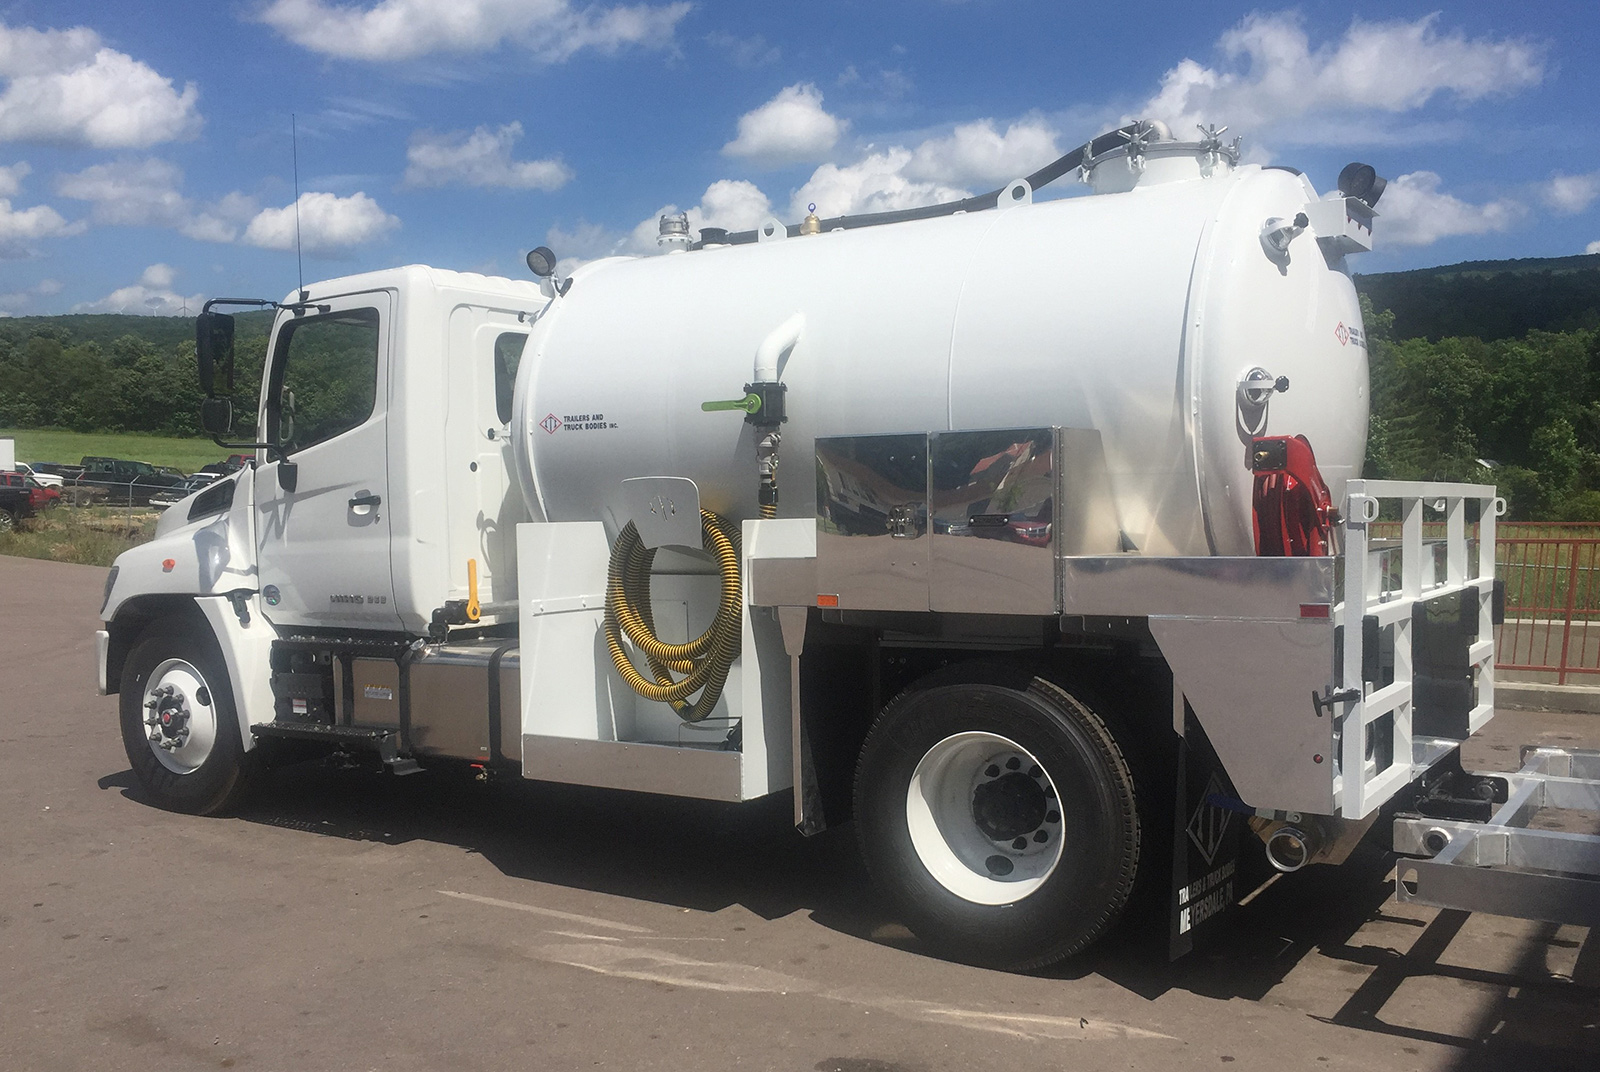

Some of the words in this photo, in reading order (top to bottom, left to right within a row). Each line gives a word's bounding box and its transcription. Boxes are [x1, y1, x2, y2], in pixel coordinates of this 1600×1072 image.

[564, 414, 590, 422] TRAILERS
[564, 423, 583, 431] TRUCK
[585, 422, 607, 430] BODIES
